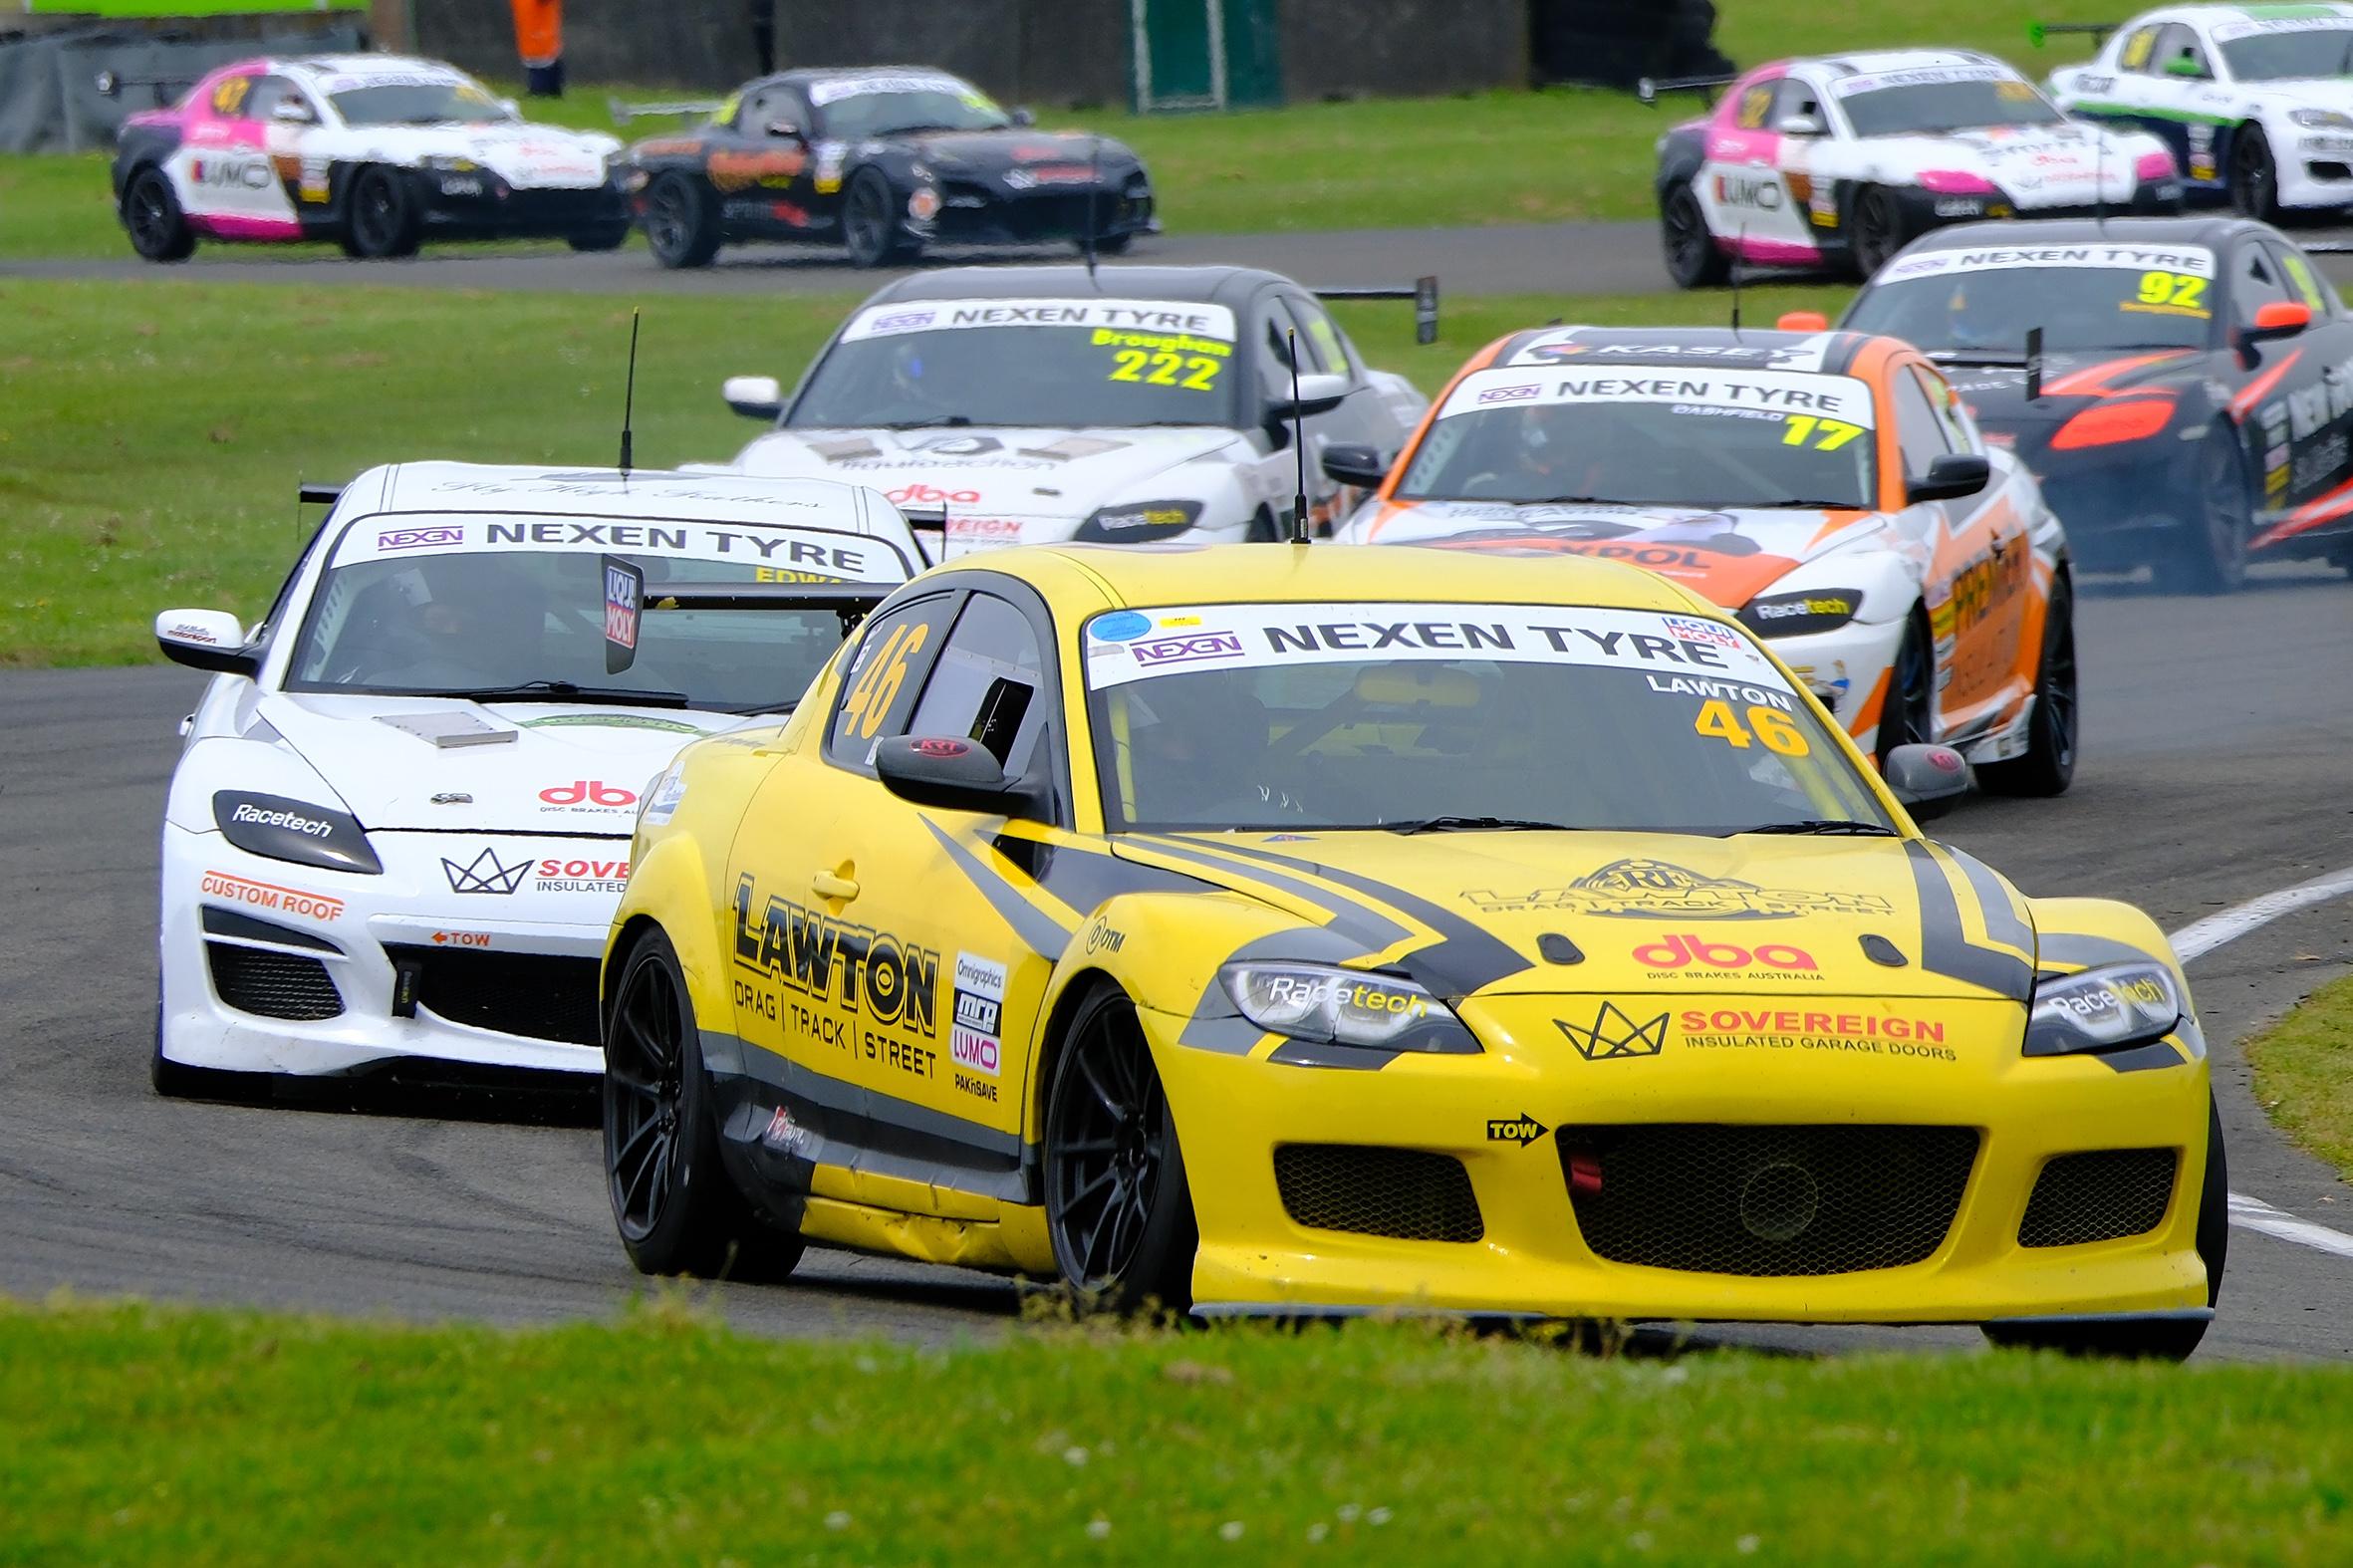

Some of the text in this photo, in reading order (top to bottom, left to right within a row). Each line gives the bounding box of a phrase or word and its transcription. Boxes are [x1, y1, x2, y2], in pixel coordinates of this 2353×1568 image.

[1961, 249, 2090, 266] NEXEN
[2105, 249, 2210, 271] TYRE
[2137, 272, 2210, 309] 92
[952, 308, 1087, 325] NEXEN
[1102, 309, 1211, 332] TYRE
[1091, 329, 1232, 357] Broughan
[1108, 349, 1222, 392] 222
[1478, 379, 1842, 413] NEXEN NEXEN TYRE
[1672, 403, 1786, 422] DASHFIELD
[1781, 414, 1865, 451] 17
[886, 483, 981, 504] dba
[1097, 509, 1187, 531] Racetech
[379, 522, 866, 574] NEXEN NEXEN TYRE
[609, 571, 635, 610] LIQUI
[607, 605, 635, 644] MOLY
[1755, 599, 1851, 620] Racetech
[1663, 618, 1733, 639] LIQUI
[1670, 628, 1739, 649] MOLY
[1131, 622, 1730, 670] NEXEN NEXEN TYRE
[844, 623, 929, 740] 46
[1647, 674, 1793, 712] LAWTON
[1695, 698, 1810, 758] 46
[232, 803, 334, 839] Racetech
[200, 876, 345, 922] CUSTOM ROOF
[536, 881, 628, 893] INSULATED
[1608, 900, 1724, 909] TRACK
[451, 931, 491, 947] TOW
[733, 872, 941, 1039] LAWTON
[1632, 933, 1819, 970] dba
[957, 958, 1002, 989] Omnigraphics
[1647, 970, 1826, 982] DISC BRAKES AUSTRALIA
[1269, 977, 1429, 1018] Racetech
[734, 979, 937, 1080] DRAG TRACK STREET
[1680, 1010, 1945, 1043] SOVEREIGN
[953, 1028, 998, 1071] LUMO
[1685, 1036, 1958, 1062] INSULATED GARAGE DOORS
[1490, 1122, 1539, 1139] TOW
